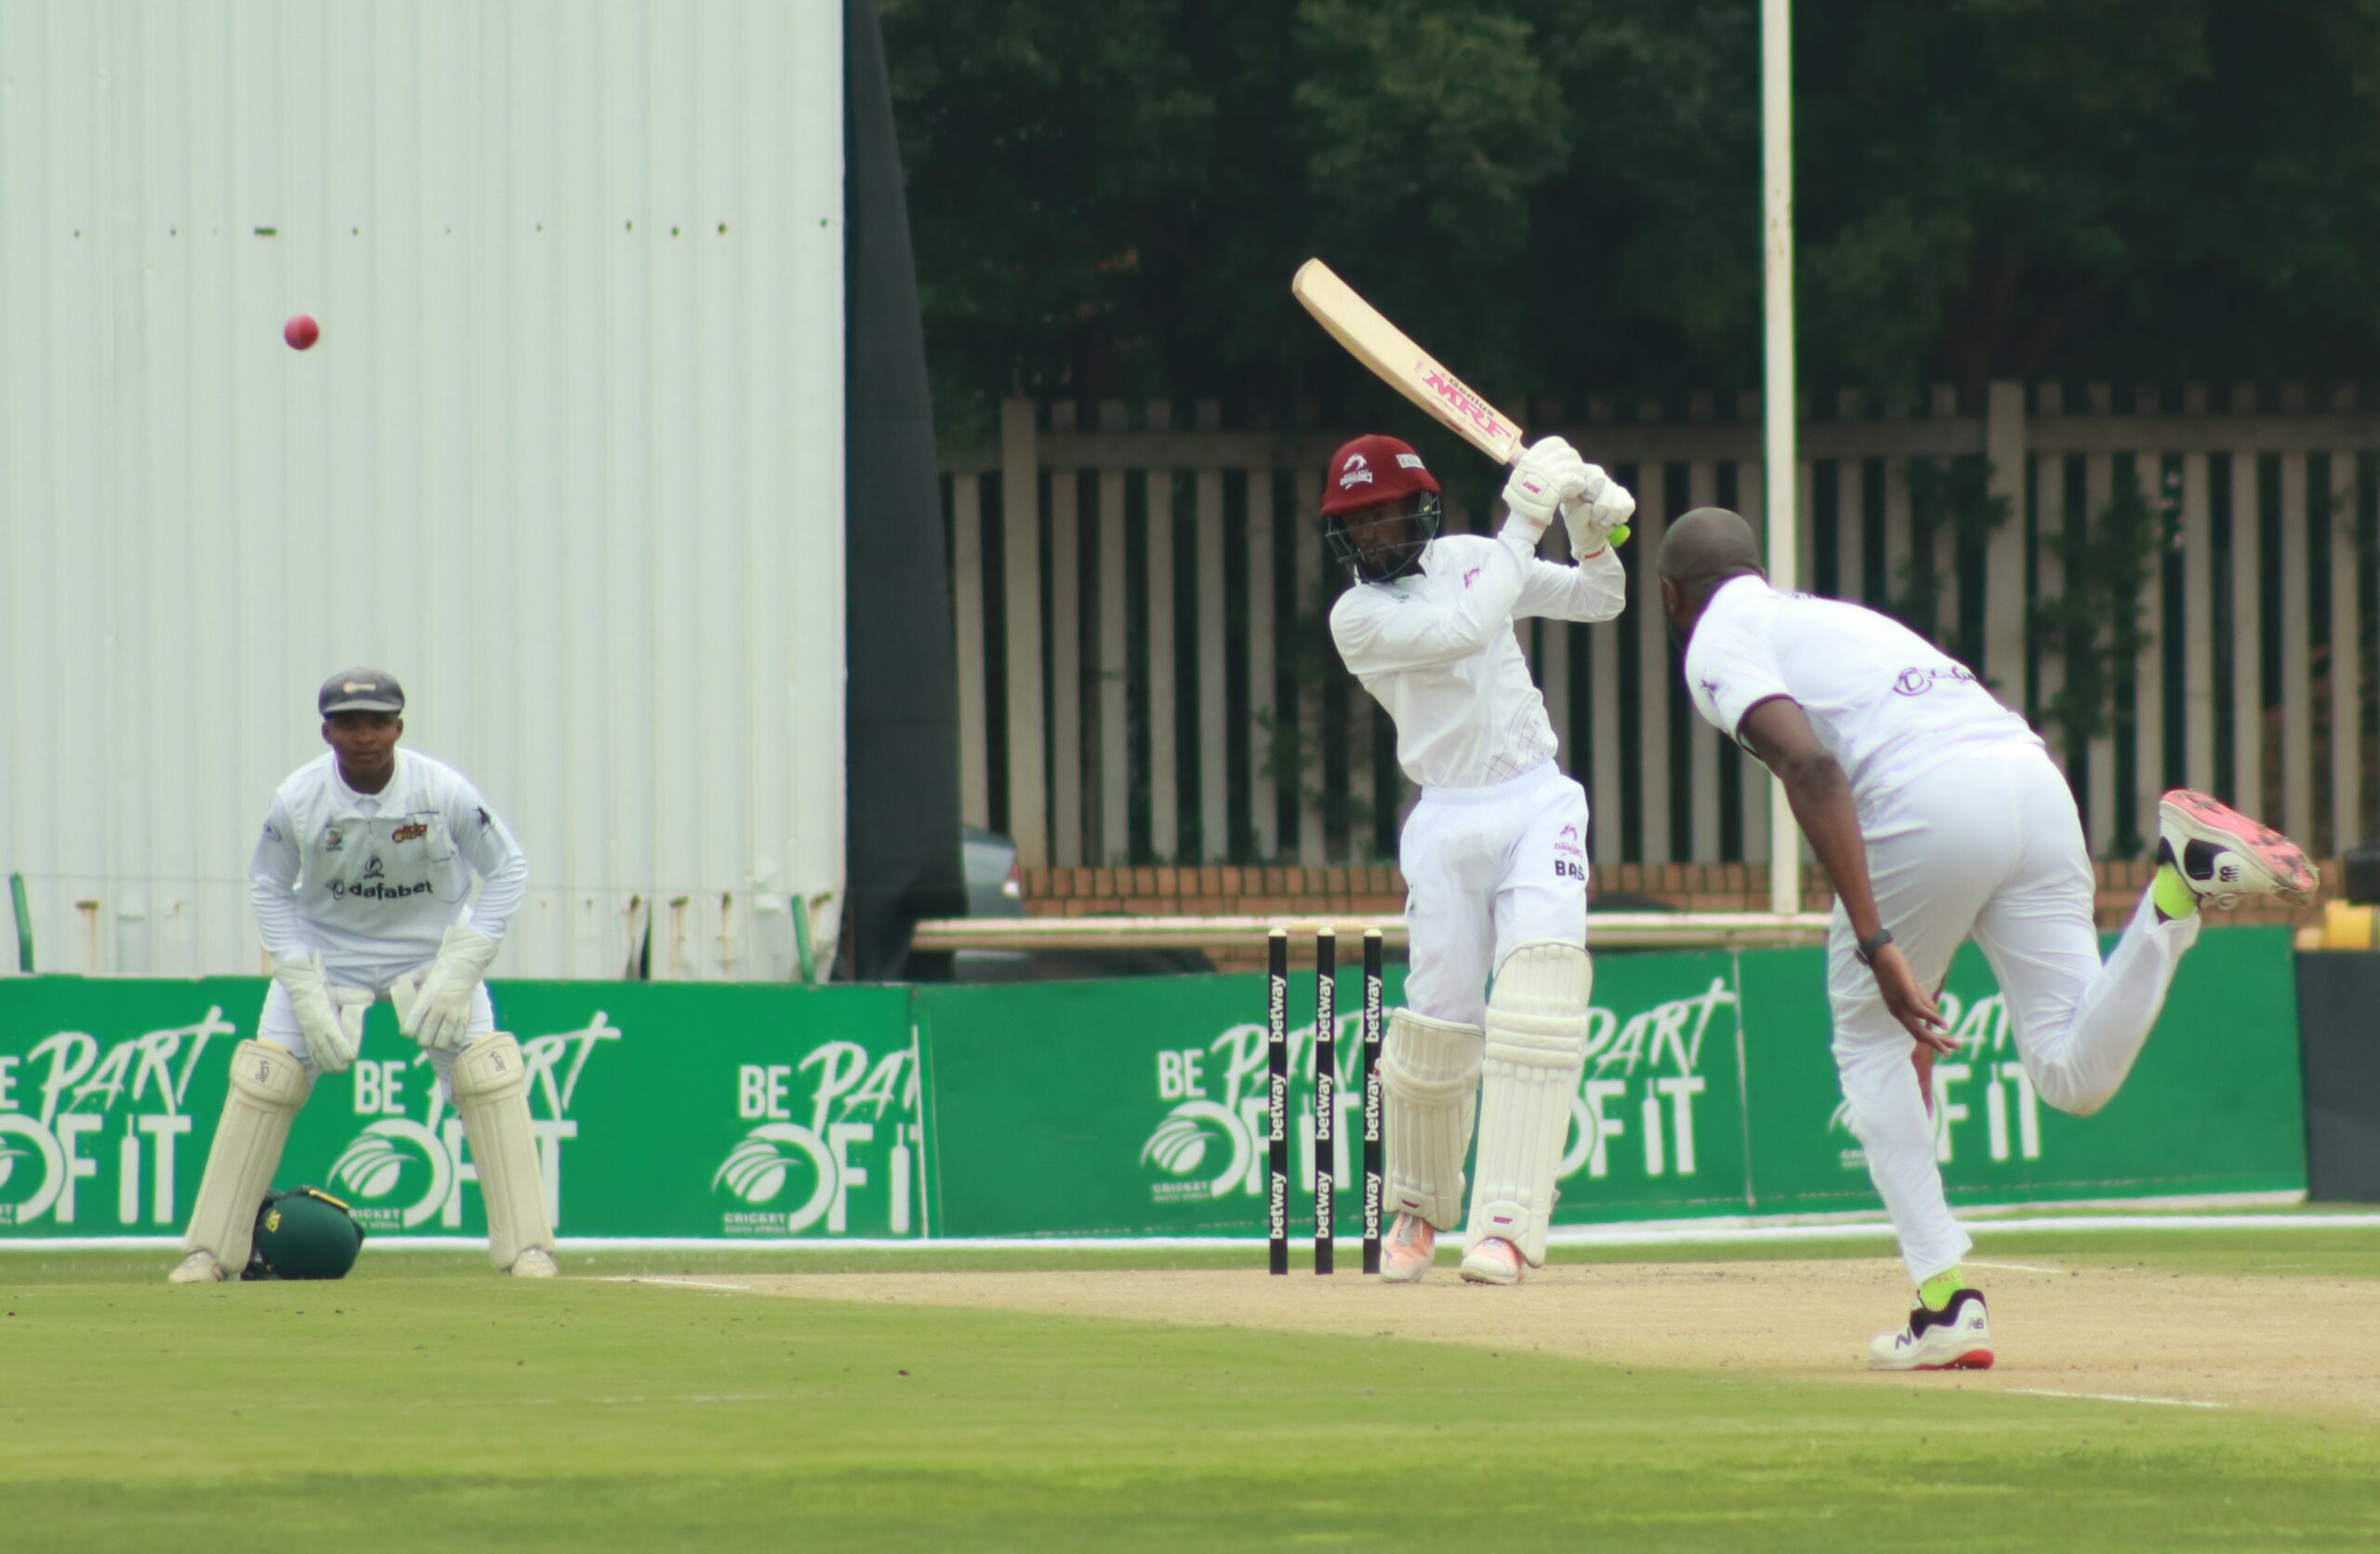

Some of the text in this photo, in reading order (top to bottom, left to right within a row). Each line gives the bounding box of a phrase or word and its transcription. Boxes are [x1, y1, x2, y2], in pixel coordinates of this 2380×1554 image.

[1422, 370, 1513, 438] MRF
[349, 880, 433, 900] dafabet
[1269, 975, 1287, 1042] betway
[1317, 974, 1334, 1042] betway
[1365, 975, 1382, 1043] betway
[0, 1004, 236, 1128] E PART
[354, 1060, 406, 1114] BE
[739, 1065, 791, 1119] BE
[1157, 1048, 1207, 1098] BE
[1269, 1072, 1287, 1141] betway
[1316, 1071, 1333, 1140] betway
[1364, 1072, 1382, 1141] betway
[1642, 1076, 1705, 1176] IT
[0, 1113, 192, 1224] OF IT
[747, 1122, 874, 1232] OF
[1168, 1099, 1270, 1196] OF
[348, 1208, 400, 1220] RICKET
[723, 1212, 786, 1224] CRICKET
[1270, 1171, 1288, 1239] betway
[1316, 1171, 1332, 1239] betway
[1364, 1171, 1382, 1240] betway
